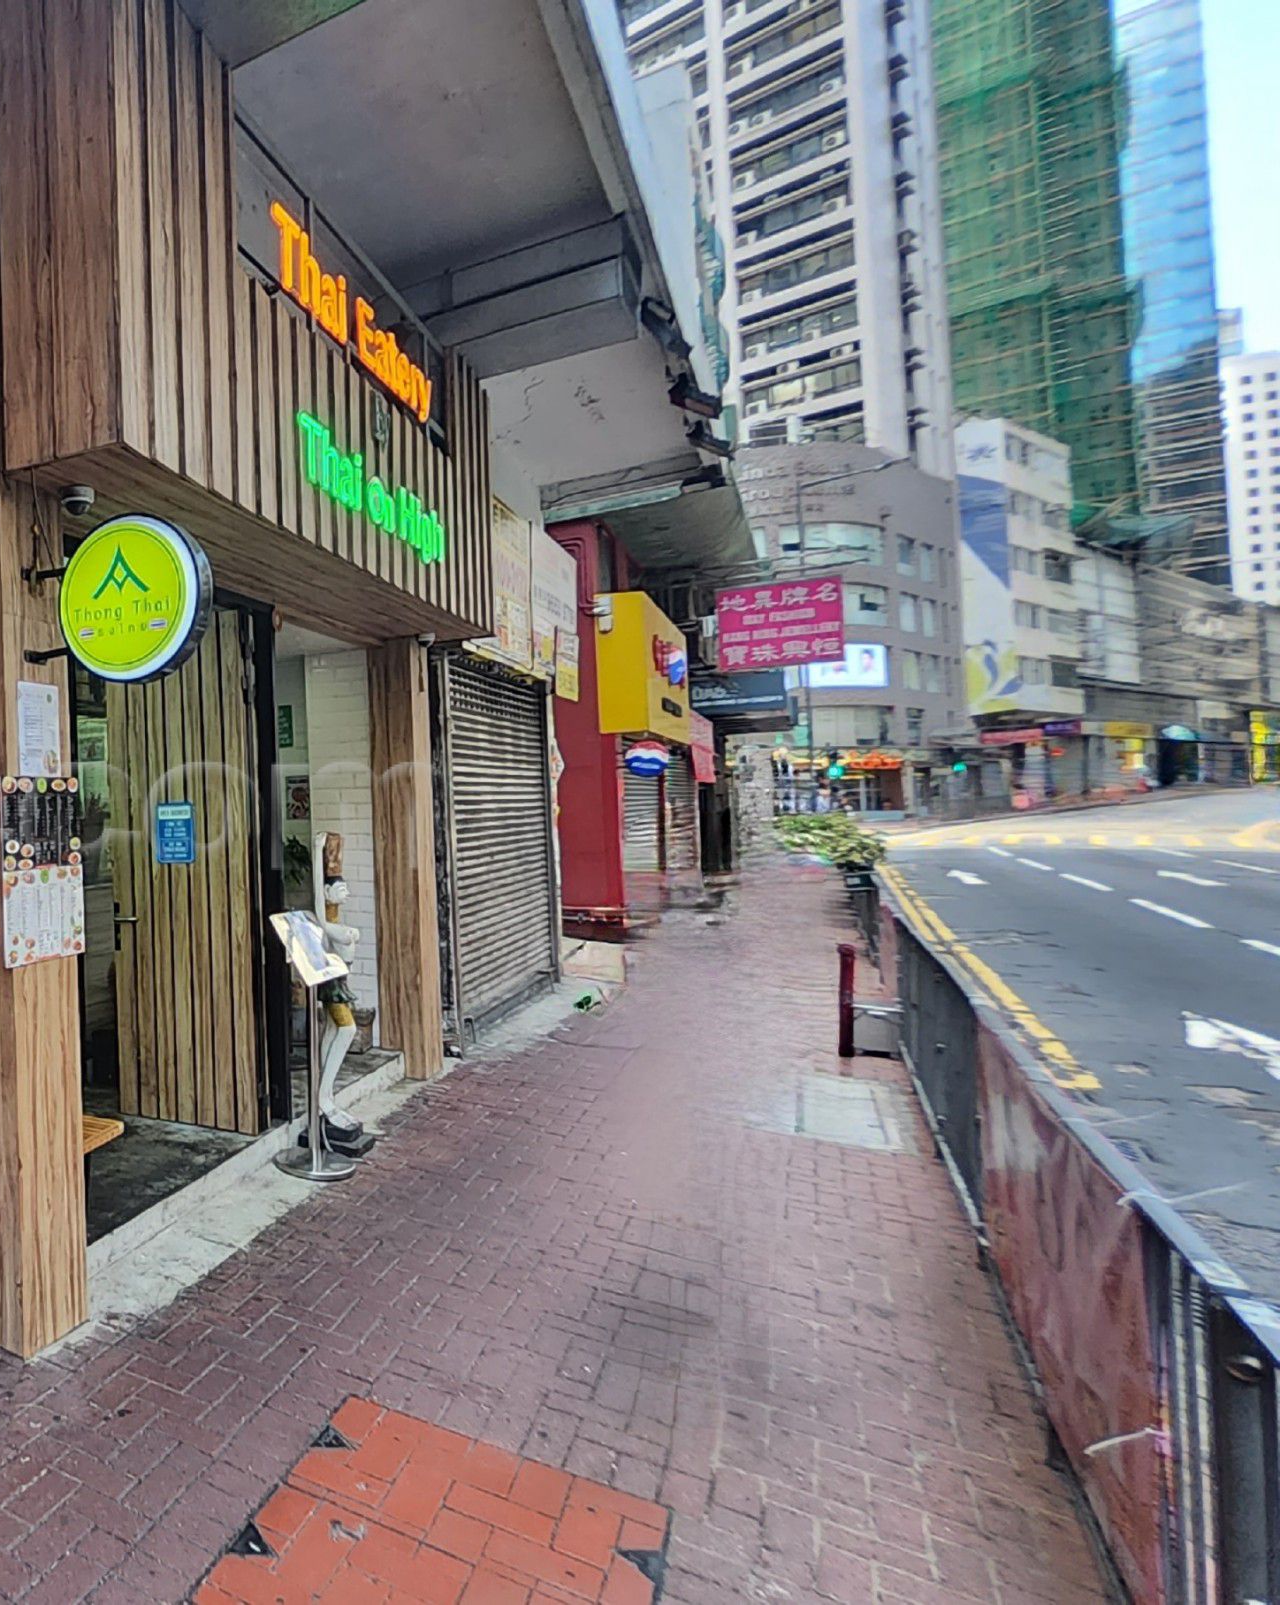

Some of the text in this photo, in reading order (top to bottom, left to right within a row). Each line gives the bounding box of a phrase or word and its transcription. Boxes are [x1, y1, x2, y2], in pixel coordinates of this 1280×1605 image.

[270, 200, 433, 424] Thai Eatery
[297, 410, 363, 512] Thai
[397, 485, 445, 566] High
[74, 596, 171, 624] Thong Thai
